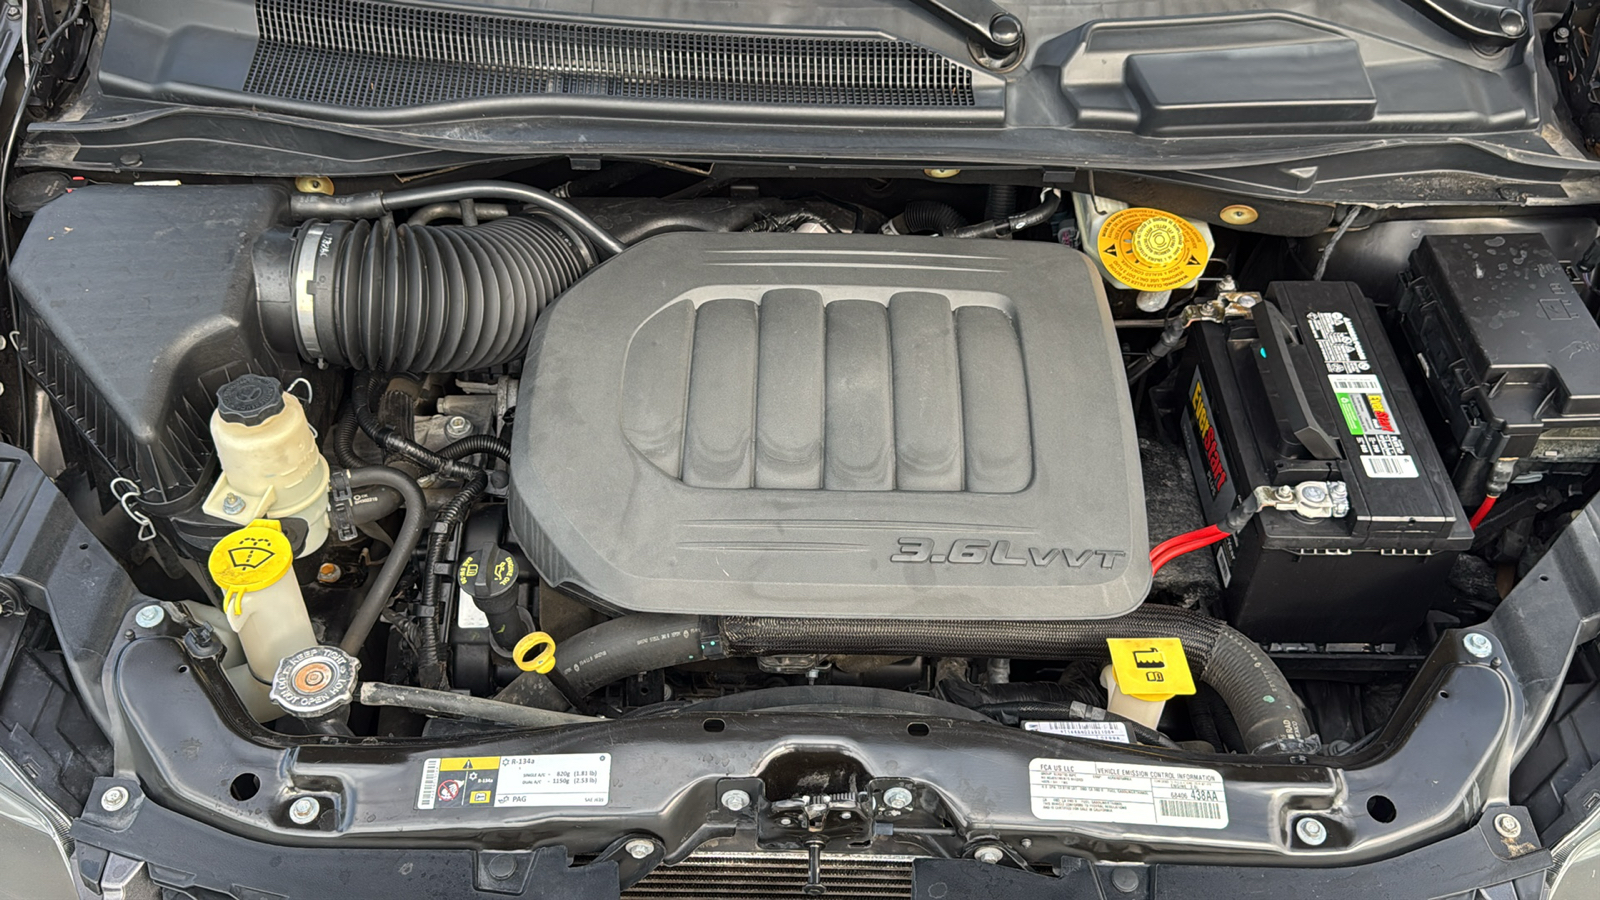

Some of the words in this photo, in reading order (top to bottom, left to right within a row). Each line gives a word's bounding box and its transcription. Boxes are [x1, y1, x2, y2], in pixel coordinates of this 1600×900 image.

[1367, 394, 1396, 433] EverStart
[1192, 381, 1227, 492] EverStart
[462, 556, 473, 567] SAE
[890, 537, 1027, 566] 3.6L
[1028, 548, 1126, 569] VVT
[505, 556, 514, 577] ENGINE
[500, 576, 510, 585] OIL
[290, 648, 318, 666] KEEP
[323, 648, 347, 665] TIGHT
[280, 690, 300, 704] NOT
[300, 693, 330, 706] OPEN
[329, 679, 346, 696] HOT
[1150, 771, 1175, 779] CONTROL
[1177, 773, 1215, 781] INFORMATION
[1190, 789, 1218, 801] 438AA
